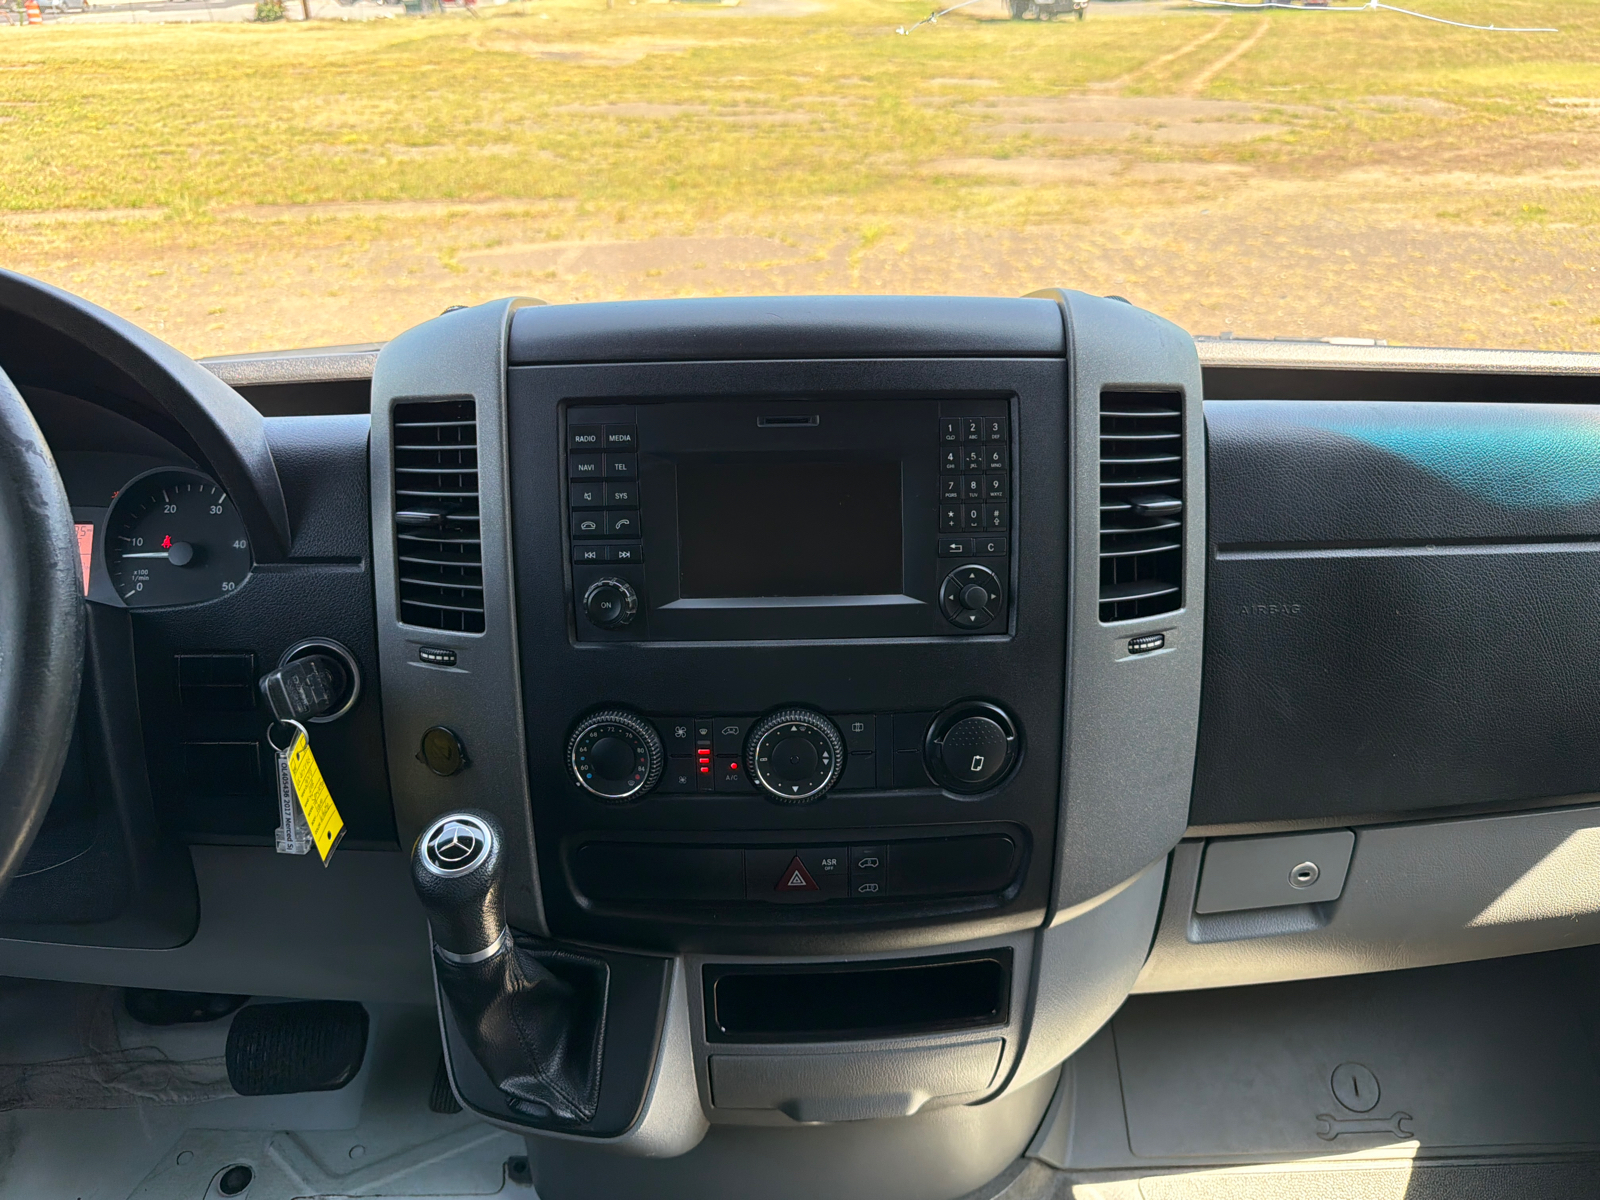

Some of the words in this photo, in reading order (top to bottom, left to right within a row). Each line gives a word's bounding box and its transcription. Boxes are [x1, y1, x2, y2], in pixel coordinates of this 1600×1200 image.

[948, 424, 952, 432] 1
[970, 423, 976, 431] 2
[992, 423, 998, 431] 3
[609, 434, 632, 442] MEDIA
[947, 453, 953, 461] 4
[971, 452, 976, 460] 5
[993, 452, 999, 460] 6
[948, 481, 954, 489] 7
[970, 481, 976, 489] 8
[993, 480, 999, 488] 9
[614, 492, 628, 500] SYS
[164, 504, 177, 514] 20
[209, 505, 222, 514] 30
[970, 510, 977, 518] 0
[132, 537, 144, 546] 10
[233, 540, 247, 549] 40
[987, 542, 994, 552] C
[136, 582, 143, 591] 0
[222, 581, 236, 591] 50
[1240, 604, 1300, 615] AIRBAG
[283, 800, 291, 816] 2017
[285, 817, 293, 842] Merced
[821, 858, 837, 866] ASR
